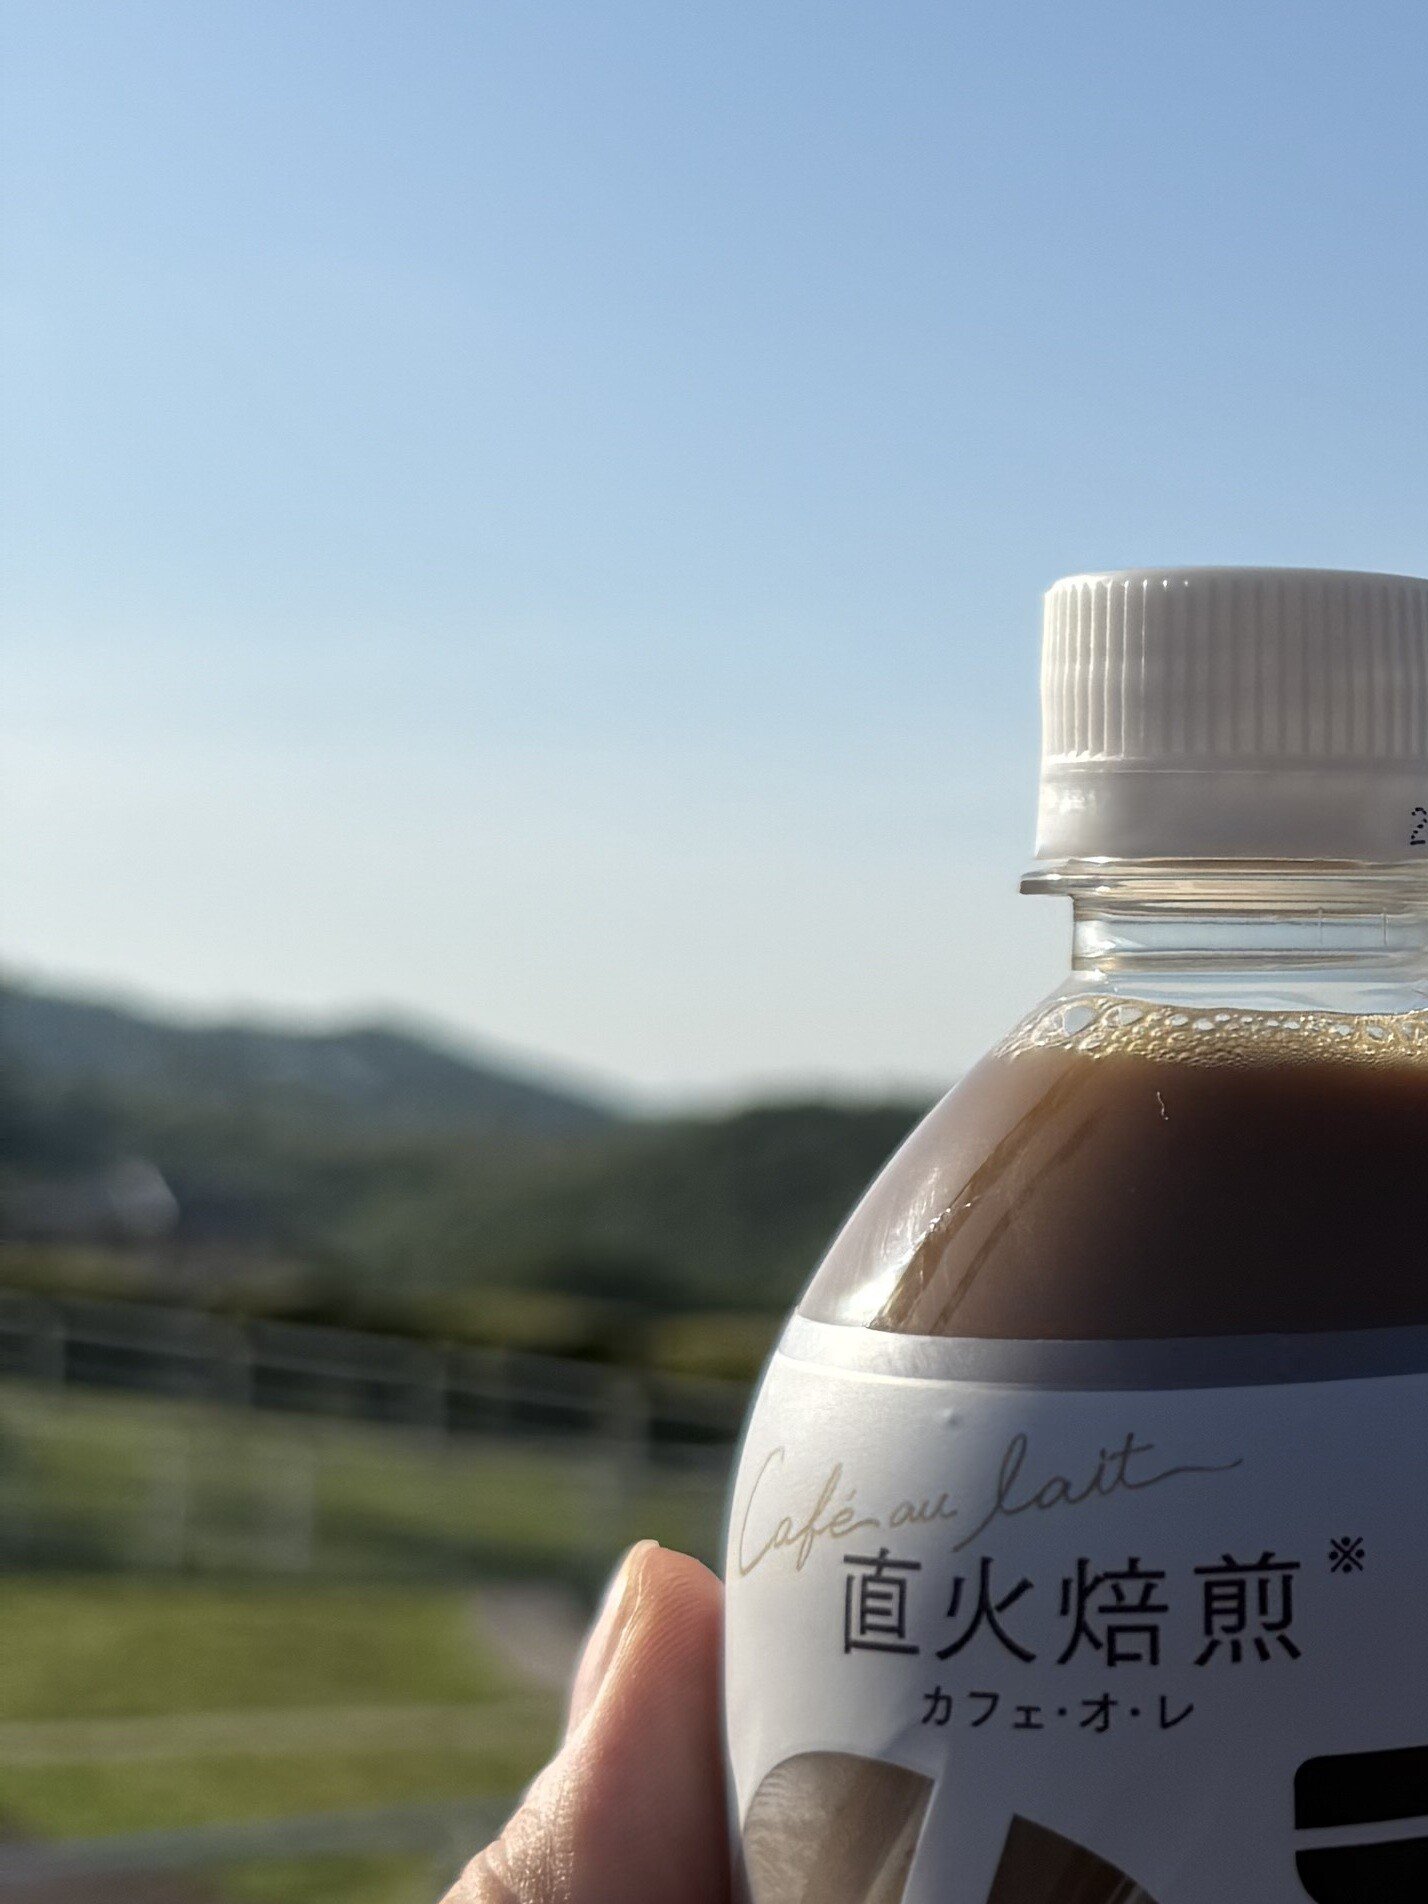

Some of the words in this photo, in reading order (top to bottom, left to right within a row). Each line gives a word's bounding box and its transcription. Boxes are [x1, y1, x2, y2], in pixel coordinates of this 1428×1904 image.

[738, 1445, 882, 1578] Café
[889, 1492, 958, 1531] au
[951, 1431, 1244, 1553] lait
